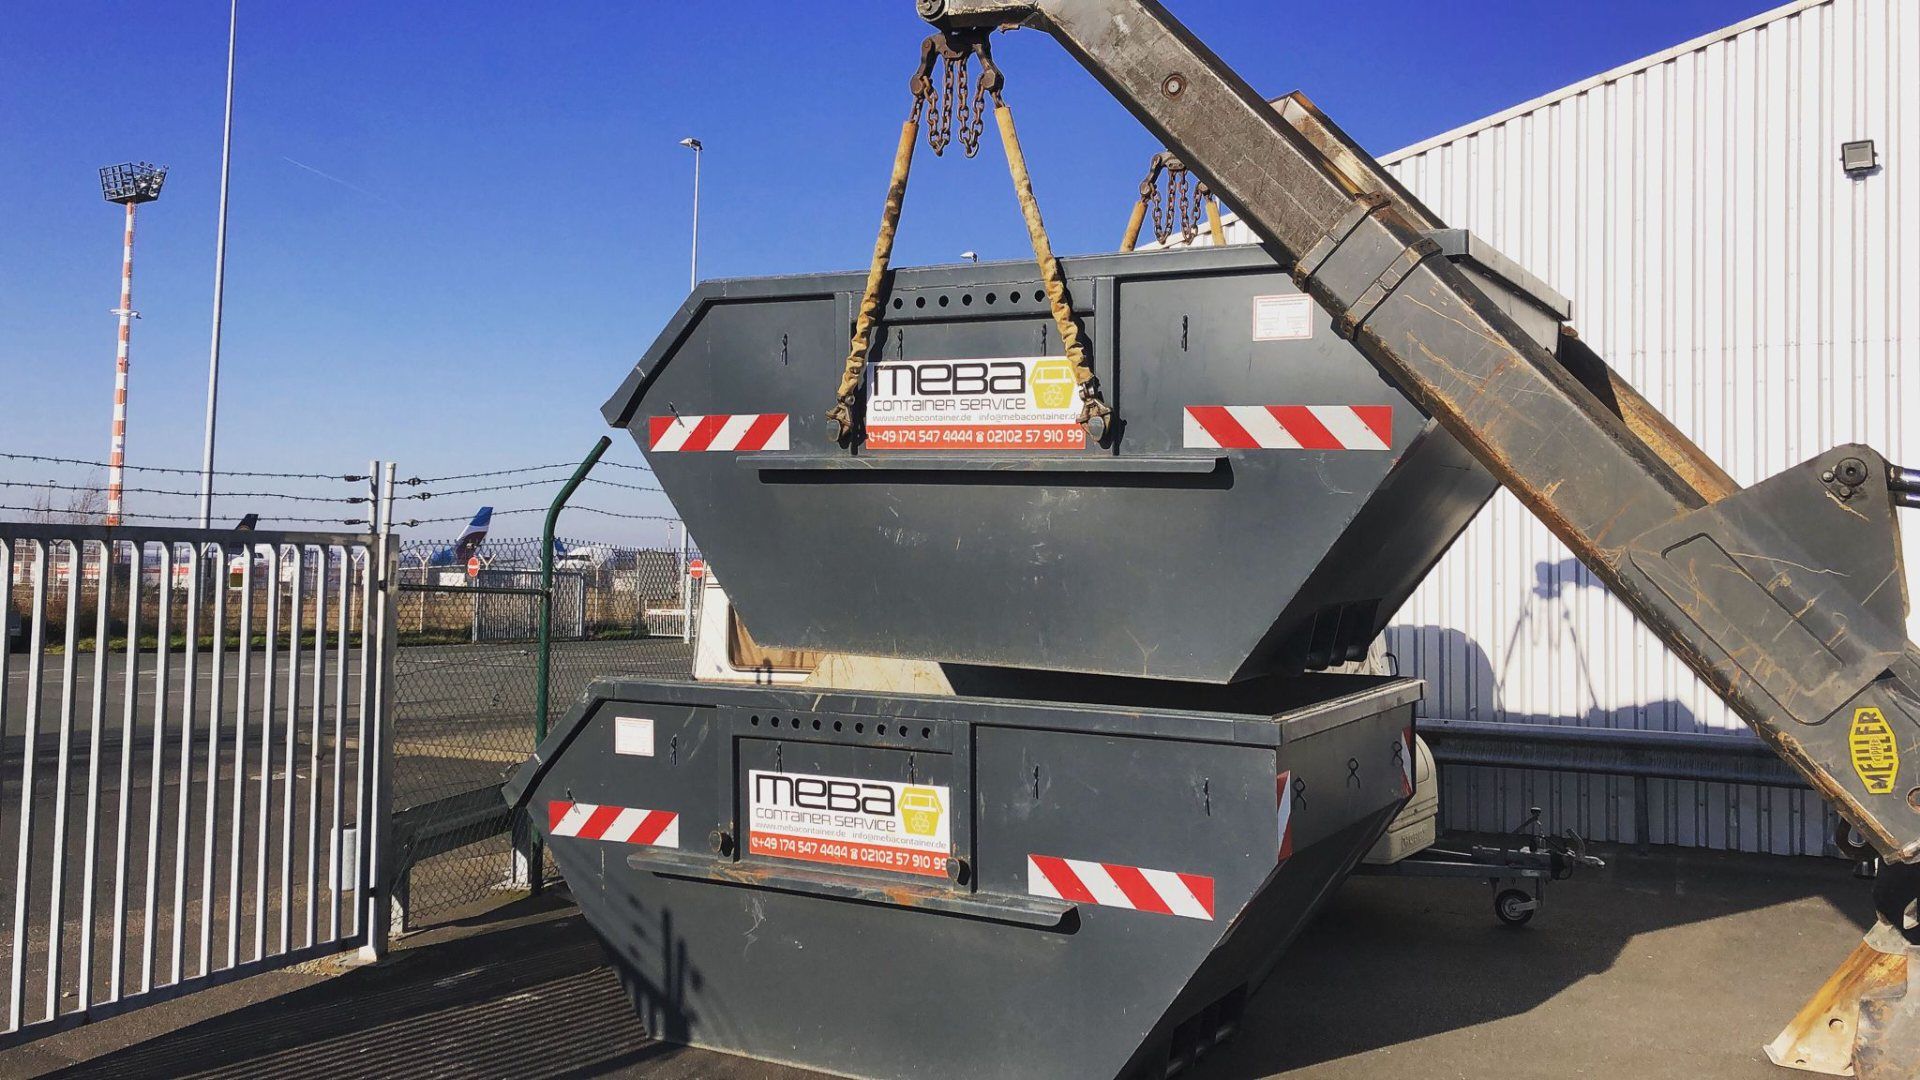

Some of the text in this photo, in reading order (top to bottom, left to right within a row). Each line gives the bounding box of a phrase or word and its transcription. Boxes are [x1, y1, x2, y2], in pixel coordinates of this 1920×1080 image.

[874, 429, 1083, 443] +49 174 547 4444 02102 57 910 99
[1854, 711, 1894, 789] MEILLER
[758, 837, 778, 850] +49
[780, 839, 796, 852] 174
[797, 841, 818, 855] 547
[819, 844, 848, 858] 4444
[860, 848, 894, 864] 02102
[895, 852, 910, 868] 57
[912, 854, 931, 869] 910
